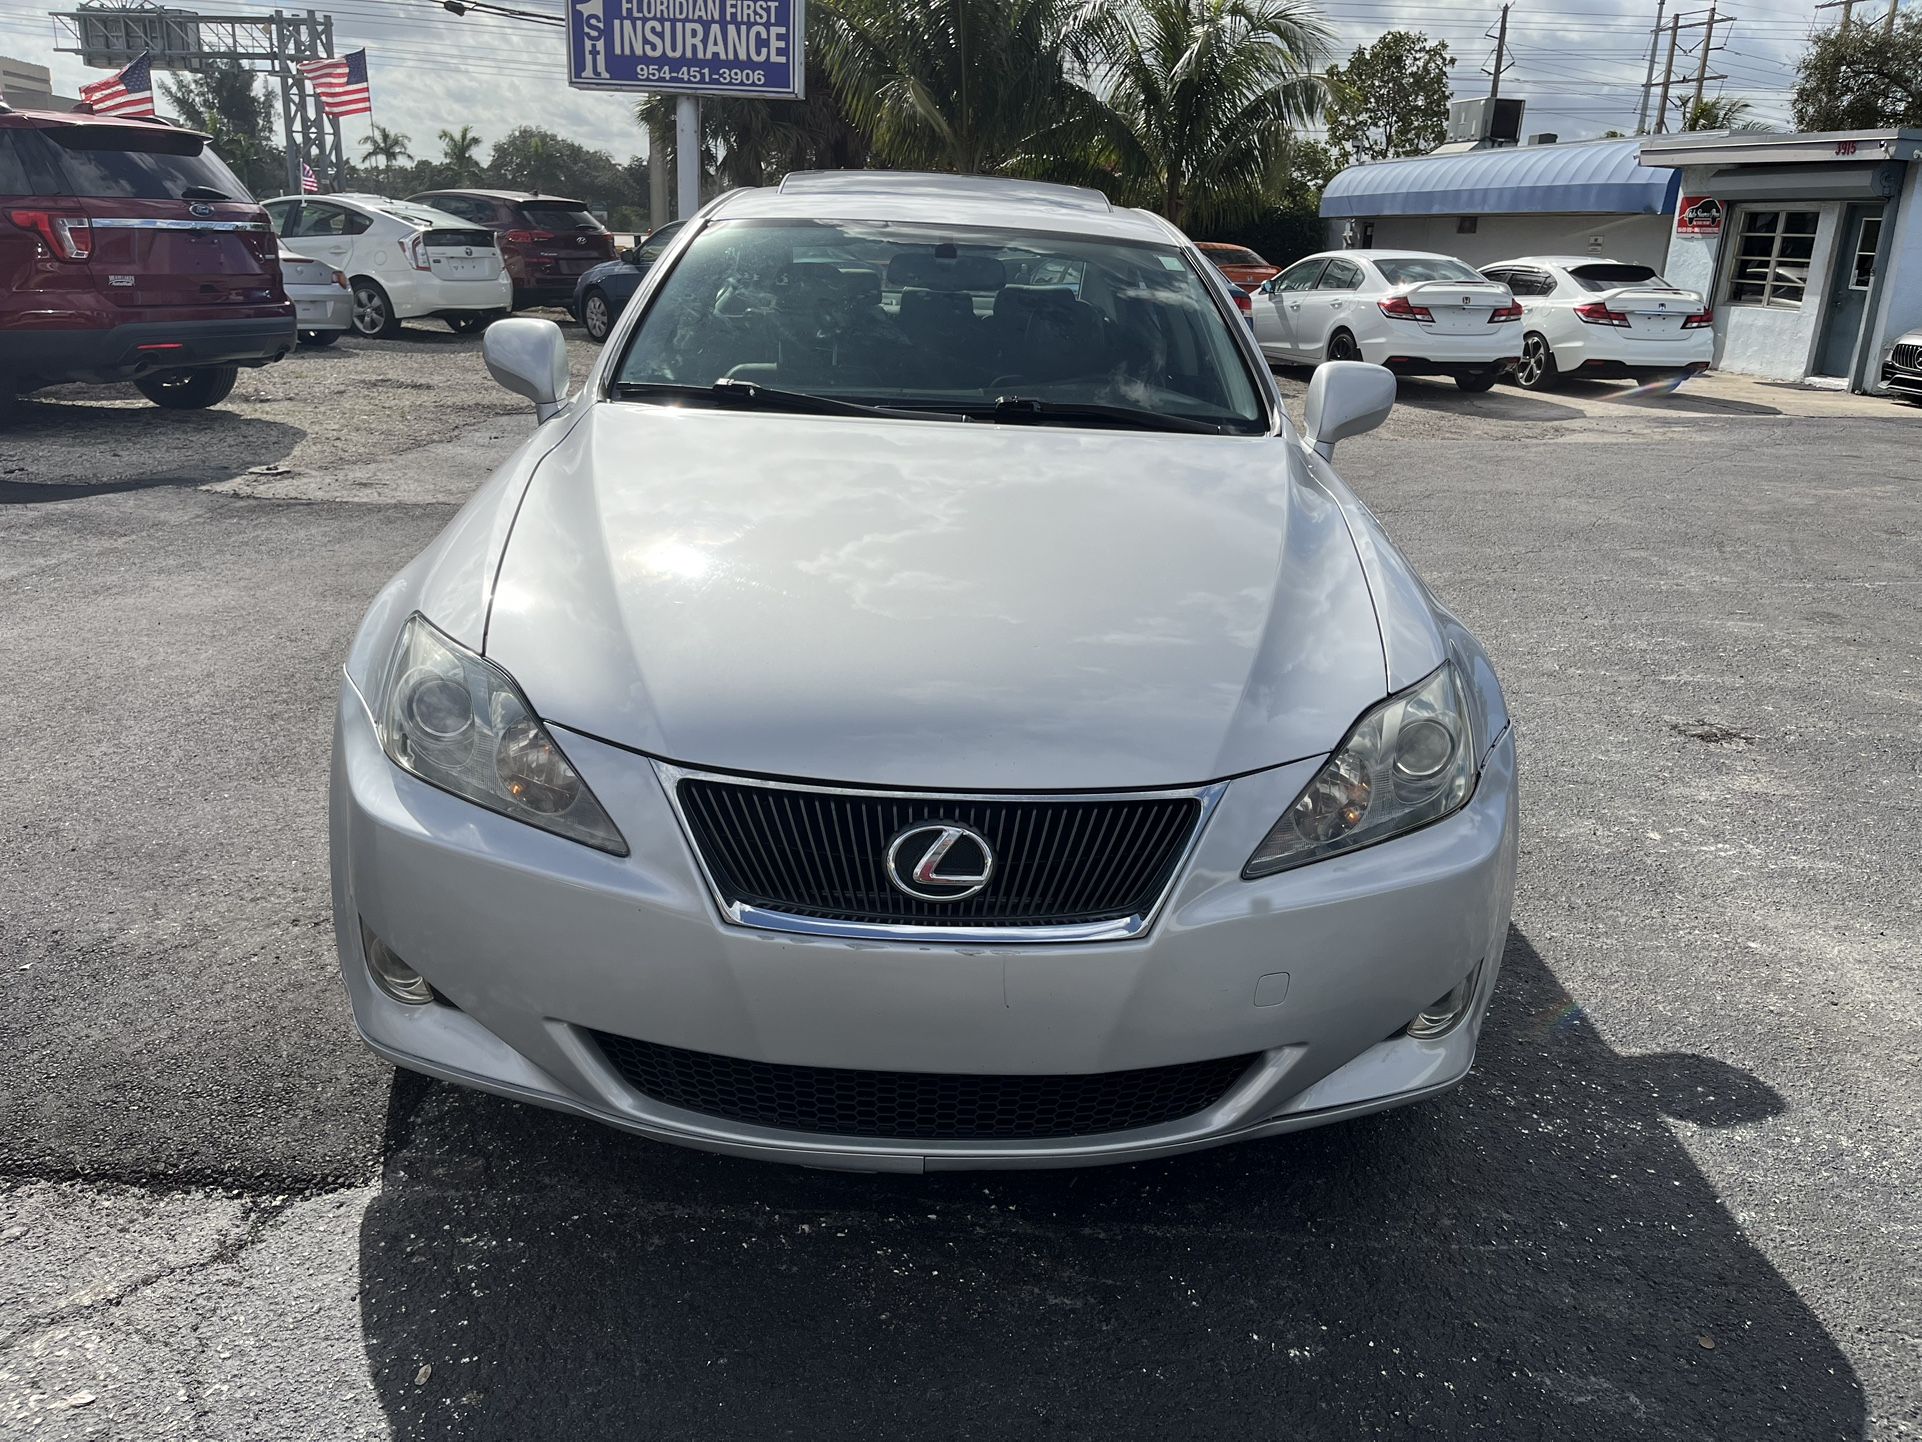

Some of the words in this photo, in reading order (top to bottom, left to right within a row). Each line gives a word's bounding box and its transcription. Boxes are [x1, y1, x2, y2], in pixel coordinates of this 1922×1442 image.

[621, 0, 720, 20] FLORIDIAN
[726, 1, 779, 23] FIRST
[614, 19, 786, 63] INSURANCE
[636, 64, 765, 85] 954-451-3906
